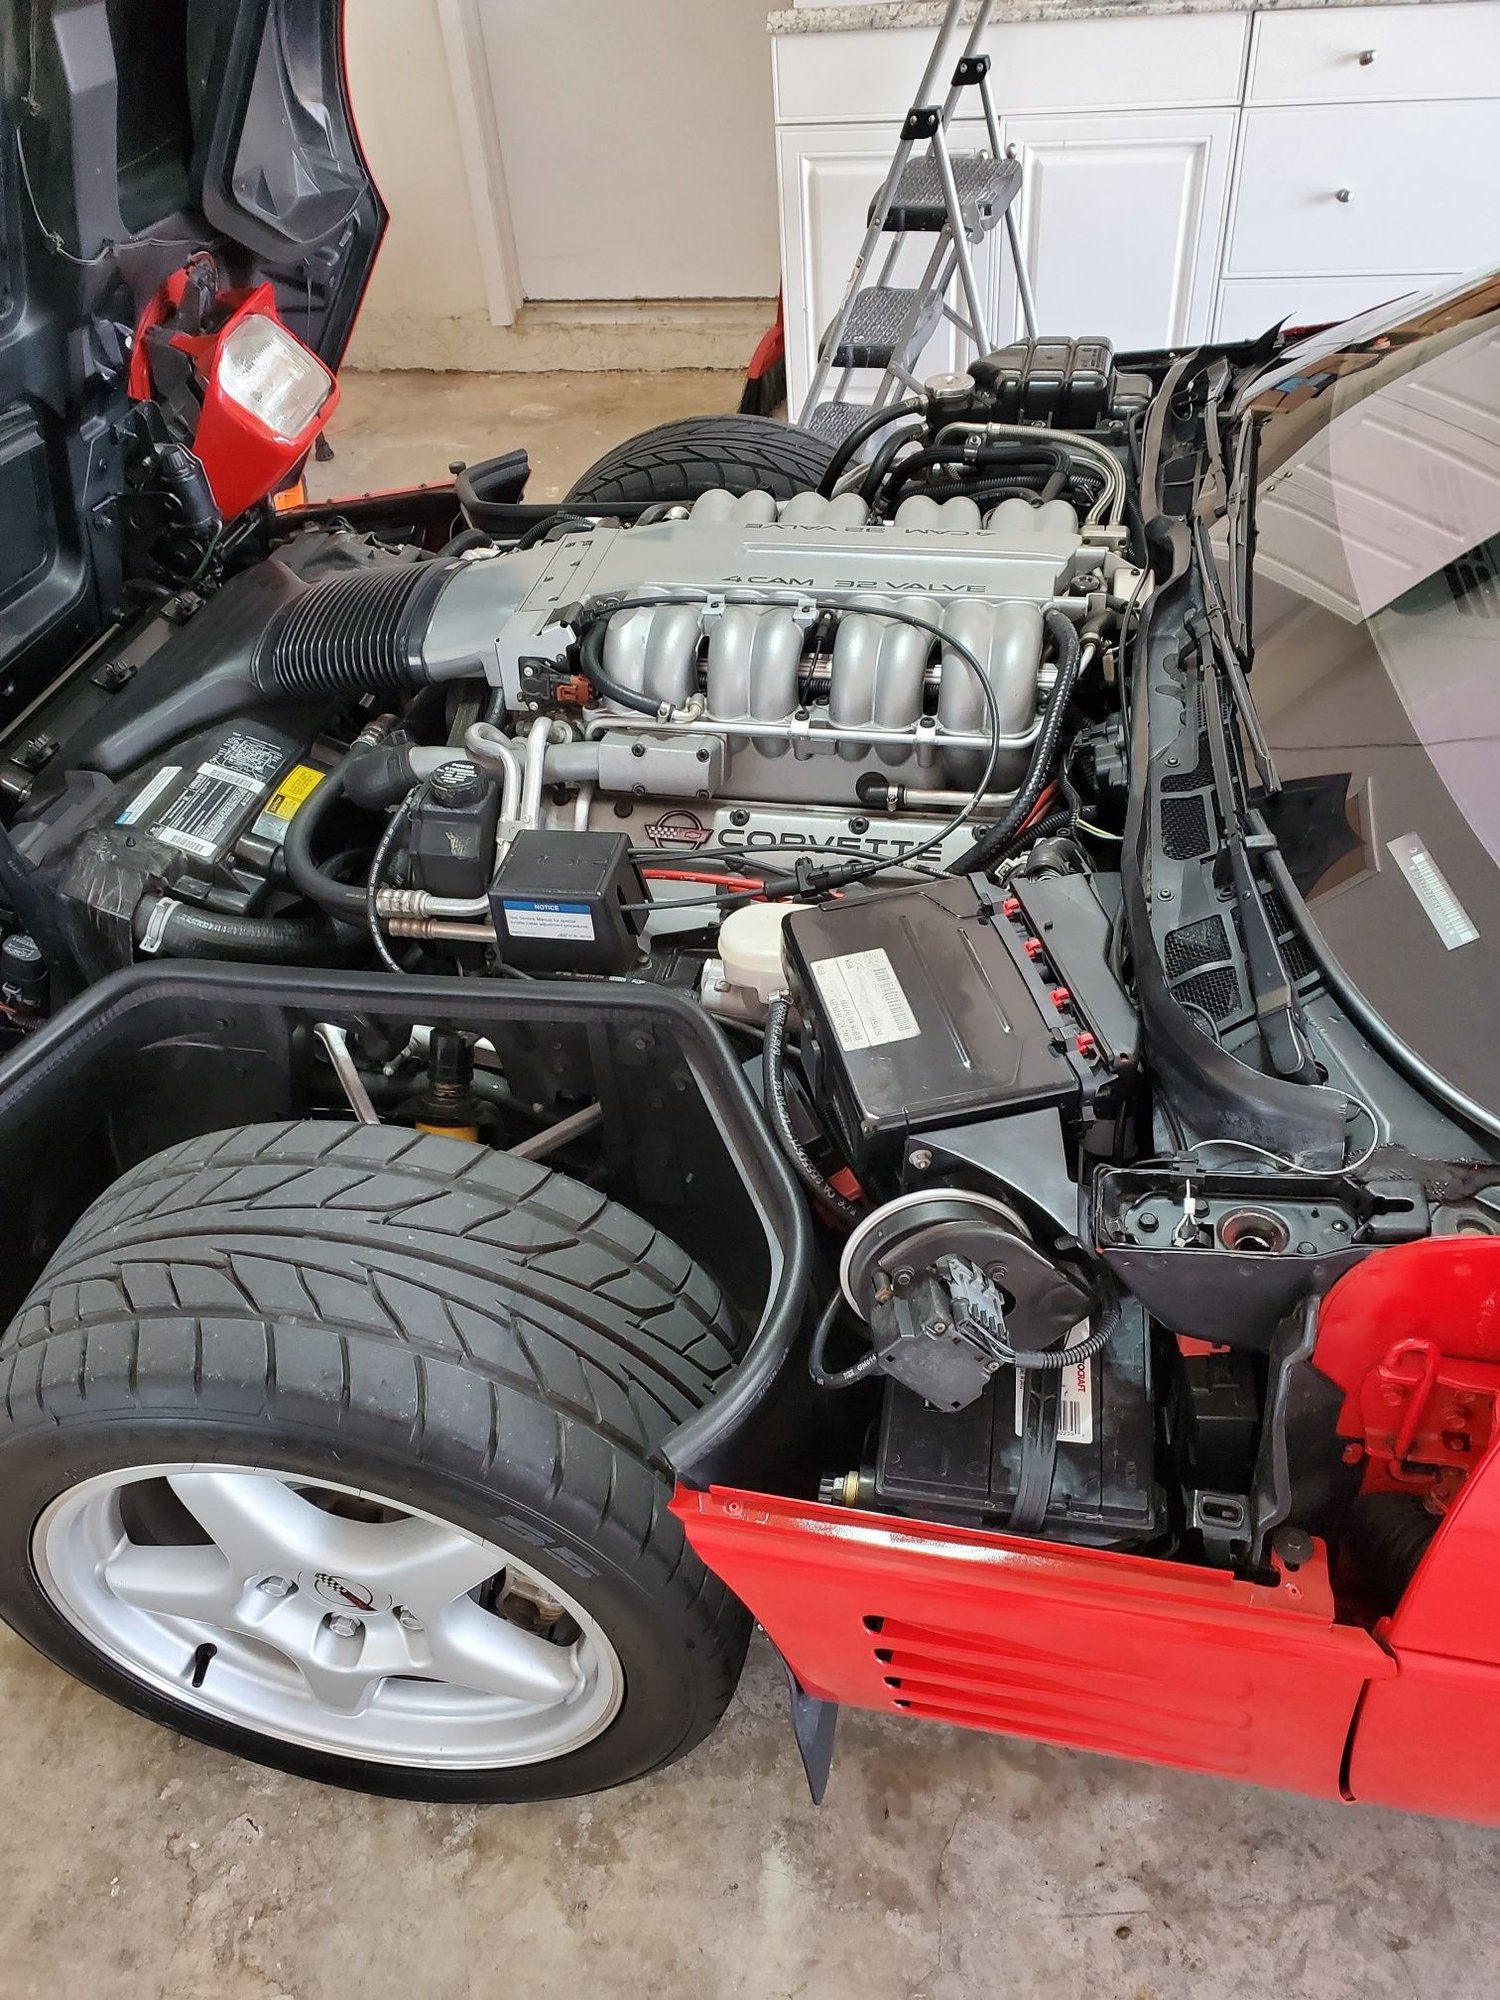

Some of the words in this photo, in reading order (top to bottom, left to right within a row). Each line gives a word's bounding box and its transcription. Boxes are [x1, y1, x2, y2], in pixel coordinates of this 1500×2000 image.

[747, 576, 815, 587] CAM
[834, 579, 878, 589] 32
[885, 581, 987, 593] VALVE
[717, 828, 943, 862] CORVETTE
[534, 904, 560, 912] NOTICE
[1077, 1361, 1086, 1392] TOCRAFT
